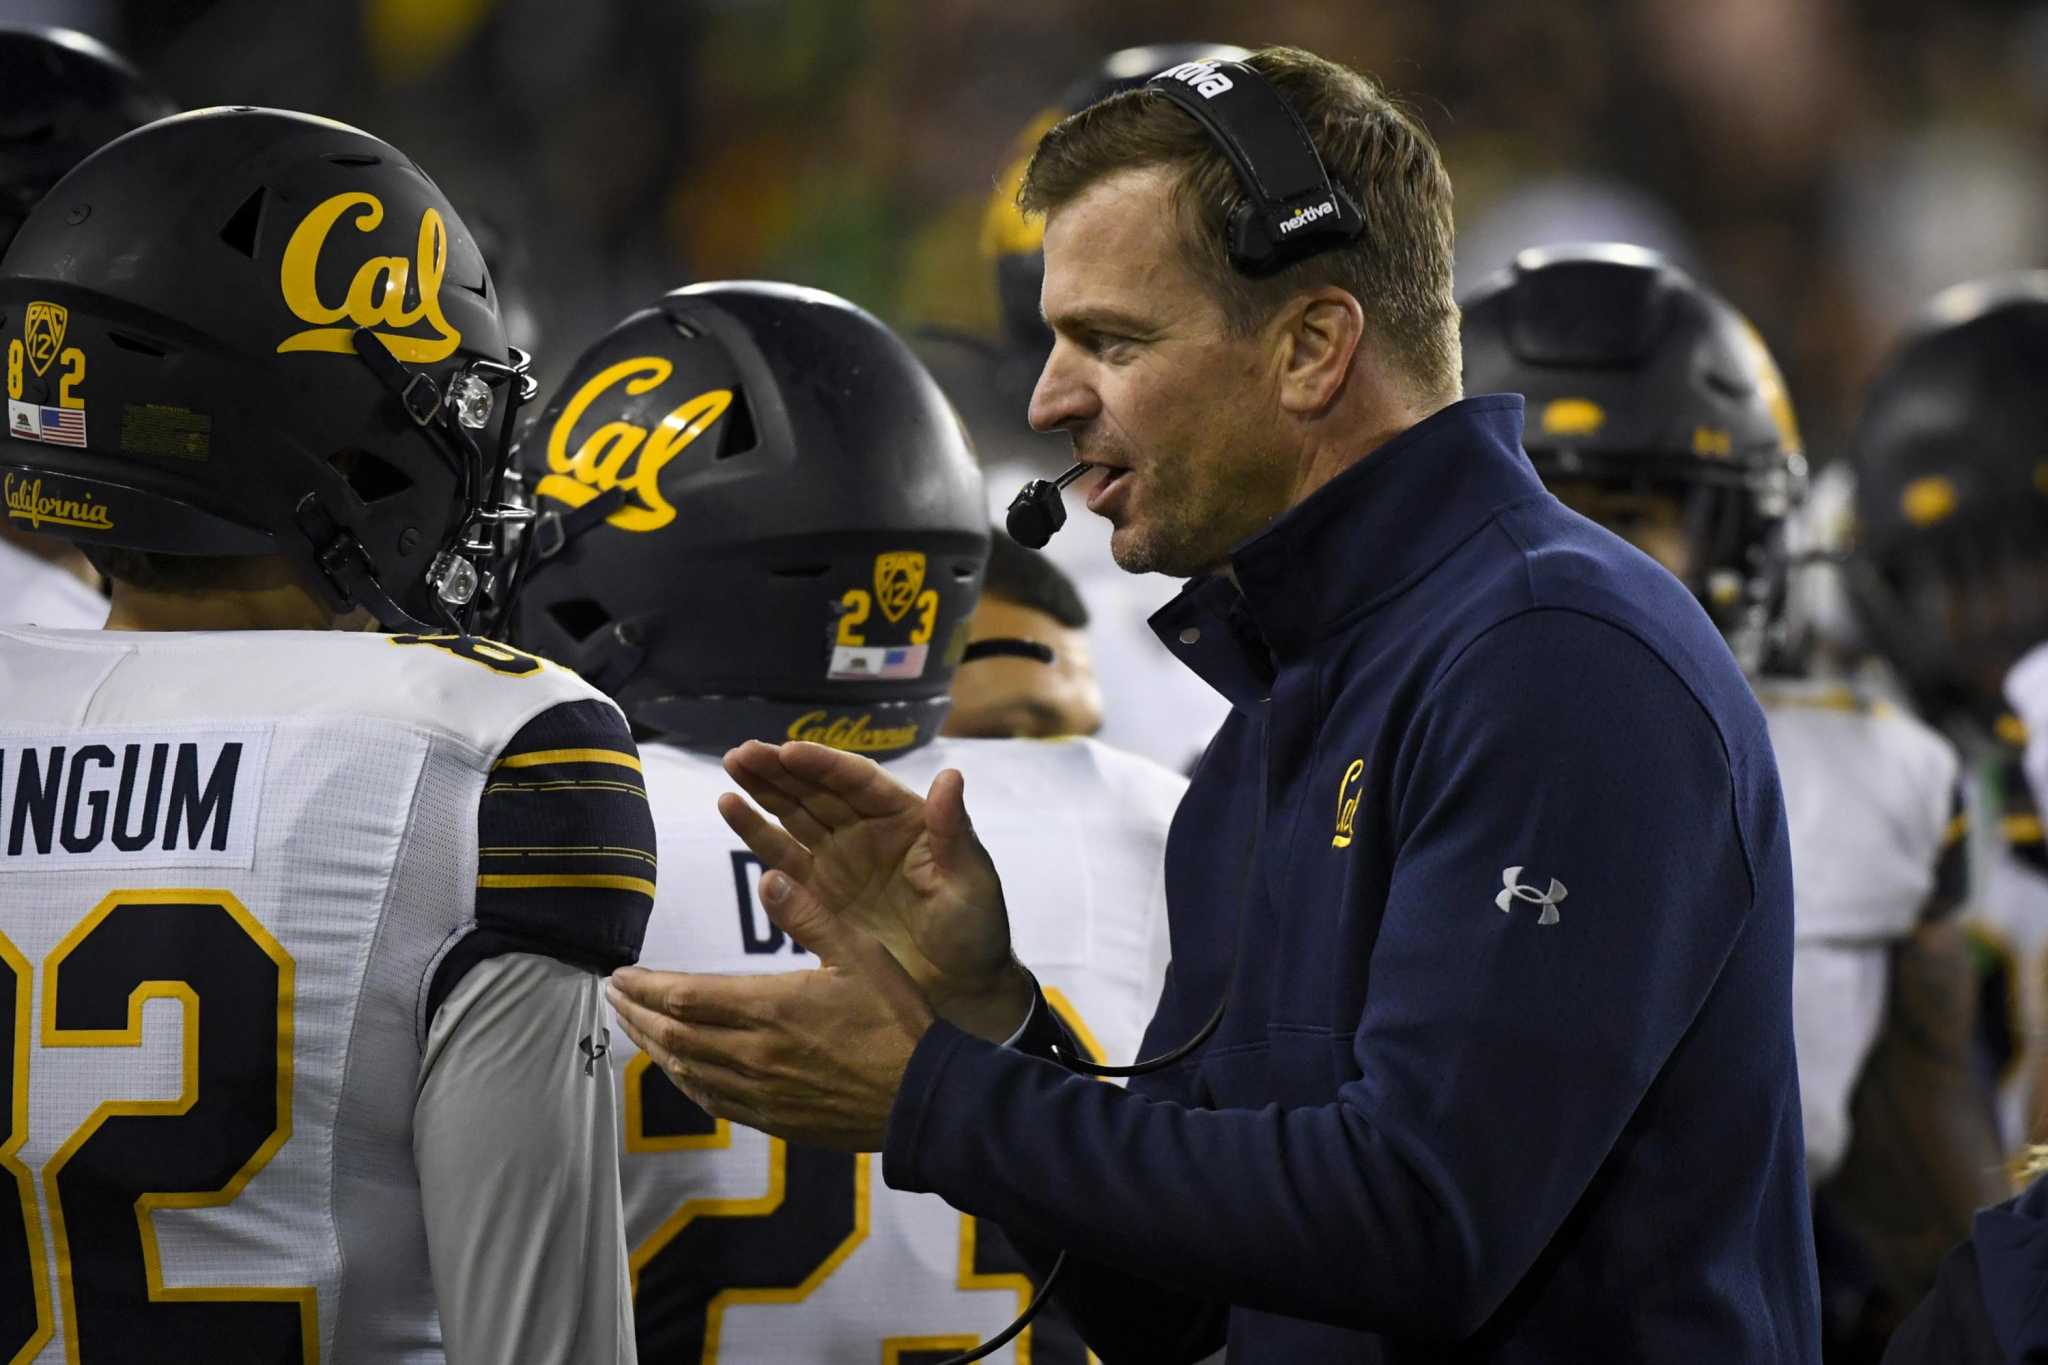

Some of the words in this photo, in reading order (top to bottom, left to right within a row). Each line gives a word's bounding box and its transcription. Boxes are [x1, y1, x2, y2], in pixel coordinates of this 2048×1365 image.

[1279, 201, 1334, 234] nextiva
[277, 191, 461, 363] Cal
[29, 304, 64, 340] PAC
[32, 333, 53, 360] 12
[59, 347, 86, 409] 2
[535, 356, 733, 532] Cal
[4, 472, 113, 528] California
[837, 589, 871, 646] 2
[910, 589, 939, 645] 3
[0, 741, 243, 855] NGUM
[0, 889, 318, 1365] 2
